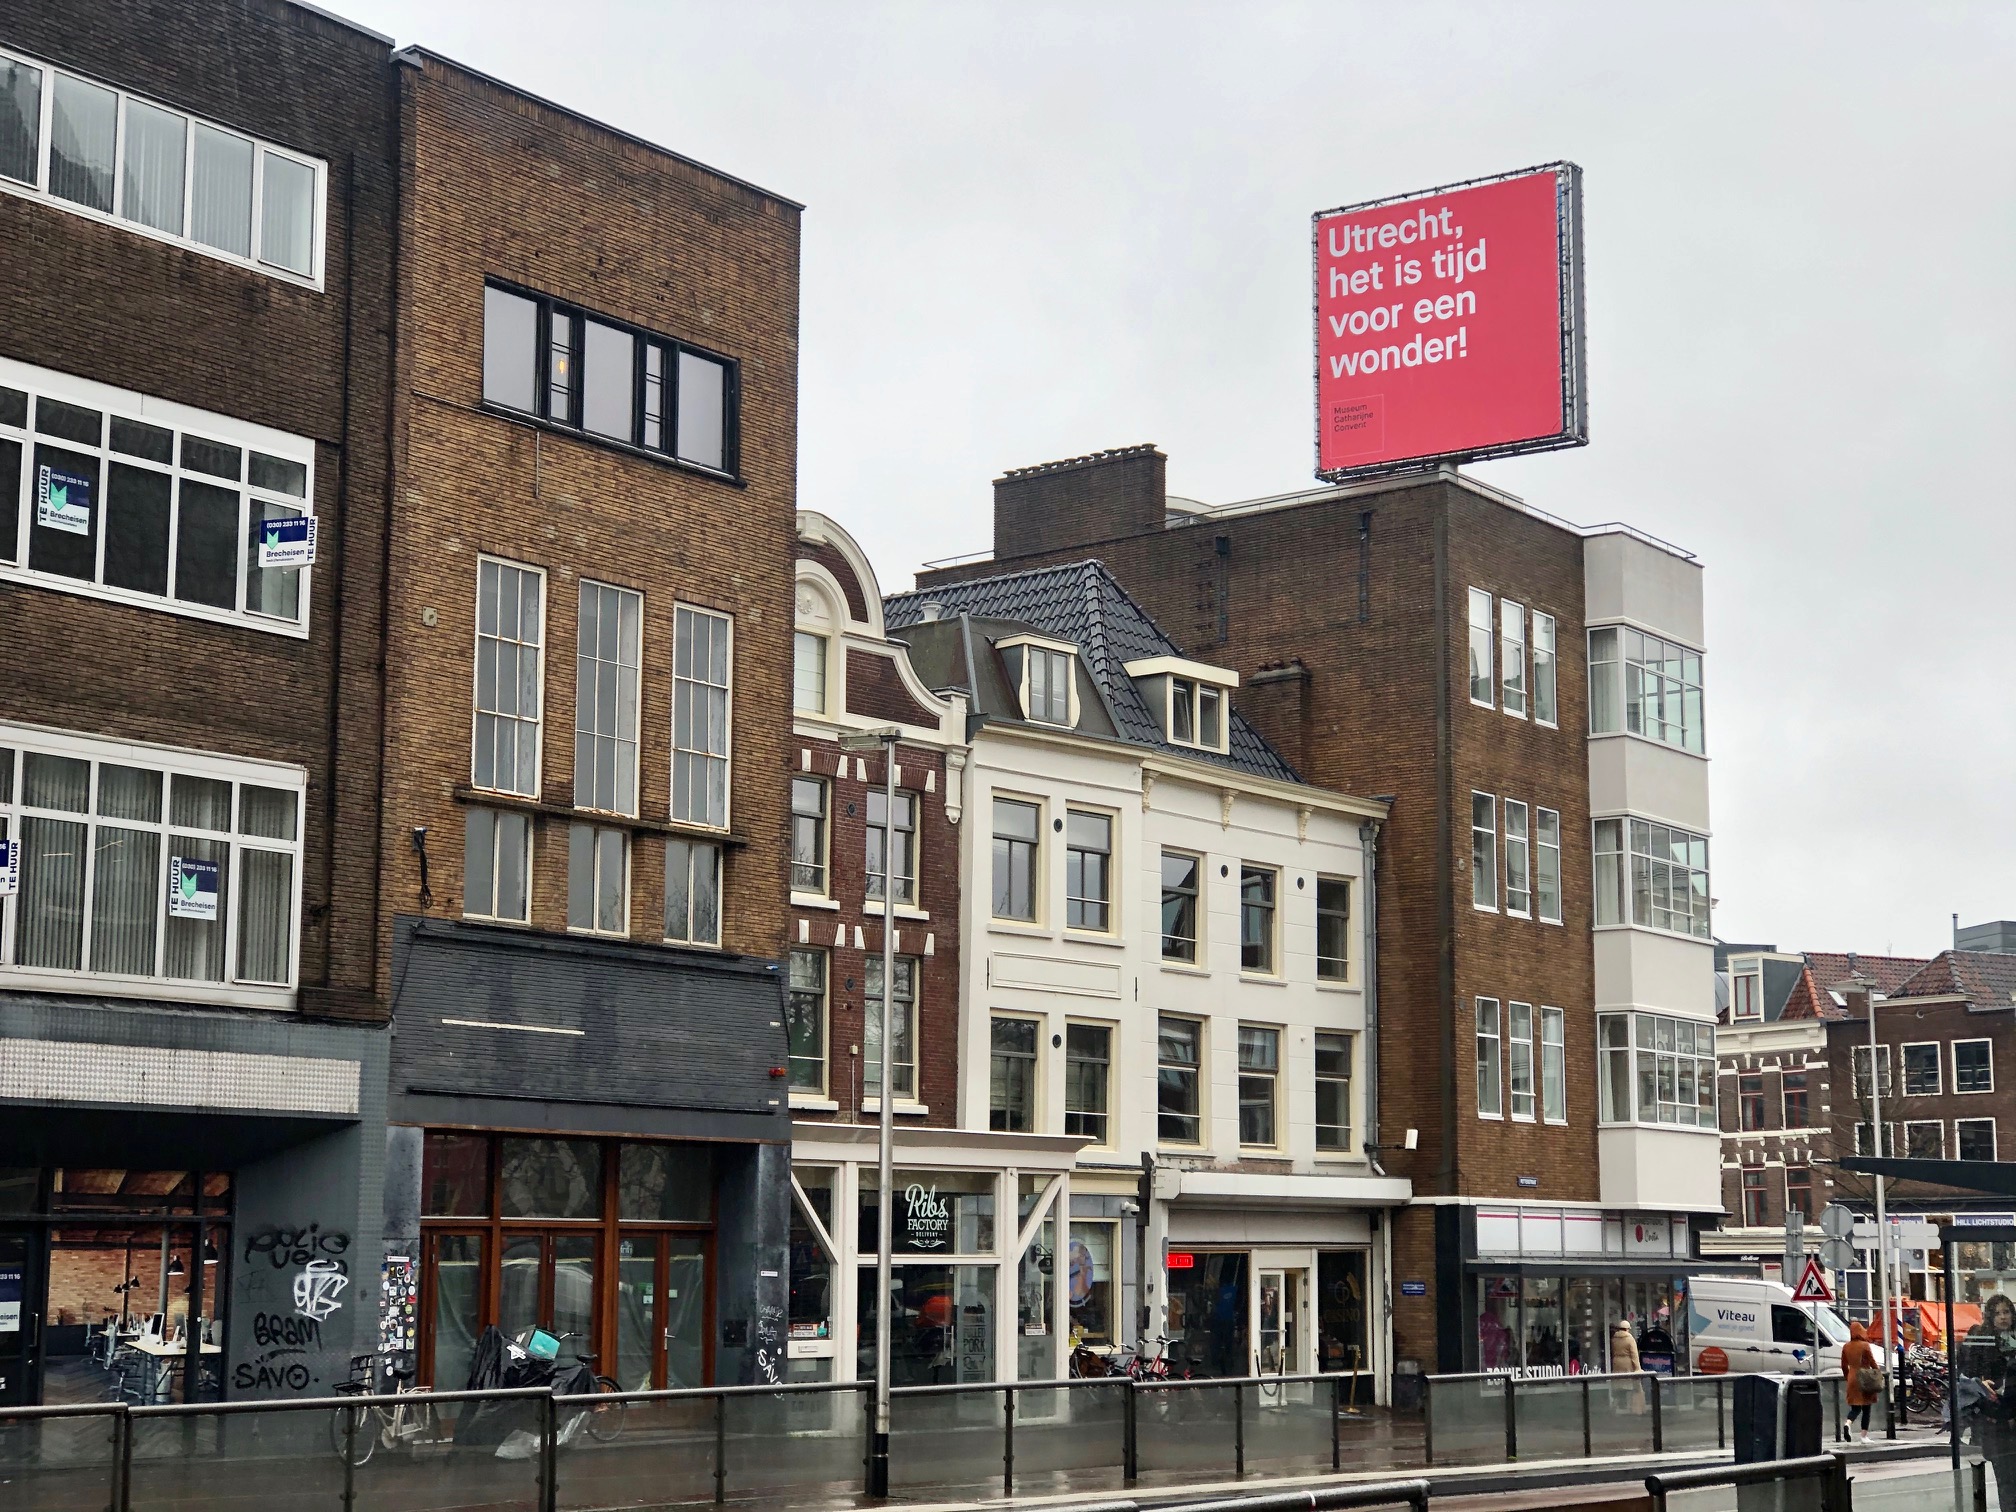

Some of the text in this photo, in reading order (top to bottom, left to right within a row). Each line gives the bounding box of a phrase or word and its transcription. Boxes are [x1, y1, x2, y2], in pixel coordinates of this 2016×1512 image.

[1328, 206, 1463, 258] Utrecht,
[1329, 238, 1487, 298] het is tijd
[1329, 290, 1476, 338] voor een
[1330, 326, 1467, 378] wonder!
[1334, 404, 1367, 414] Museum
[1334, 412, 1374, 423] Catharijne
[1334, 421, 1367, 432] Convent
[39, 468, 49, 522] TE HUUR
[50, 510, 88, 525] Brecheisen
[307, 518, 316, 561] TE HUUR
[266, 549, 305, 557] Brecheisen
[9, 842, 19, 890] TE HUUR
[171, 859, 180, 913] TE HUUR
[180, 900, 216, 910] Brecheisen
[905, 1183, 949, 1218] Ribs
[907, 1219, 949, 1230] FACTORY
[1717, 1309, 1755, 1322] Viteau
[963, 1338, 985, 1352] PORK
[1526, 1364, 1564, 1380] STUDIO
